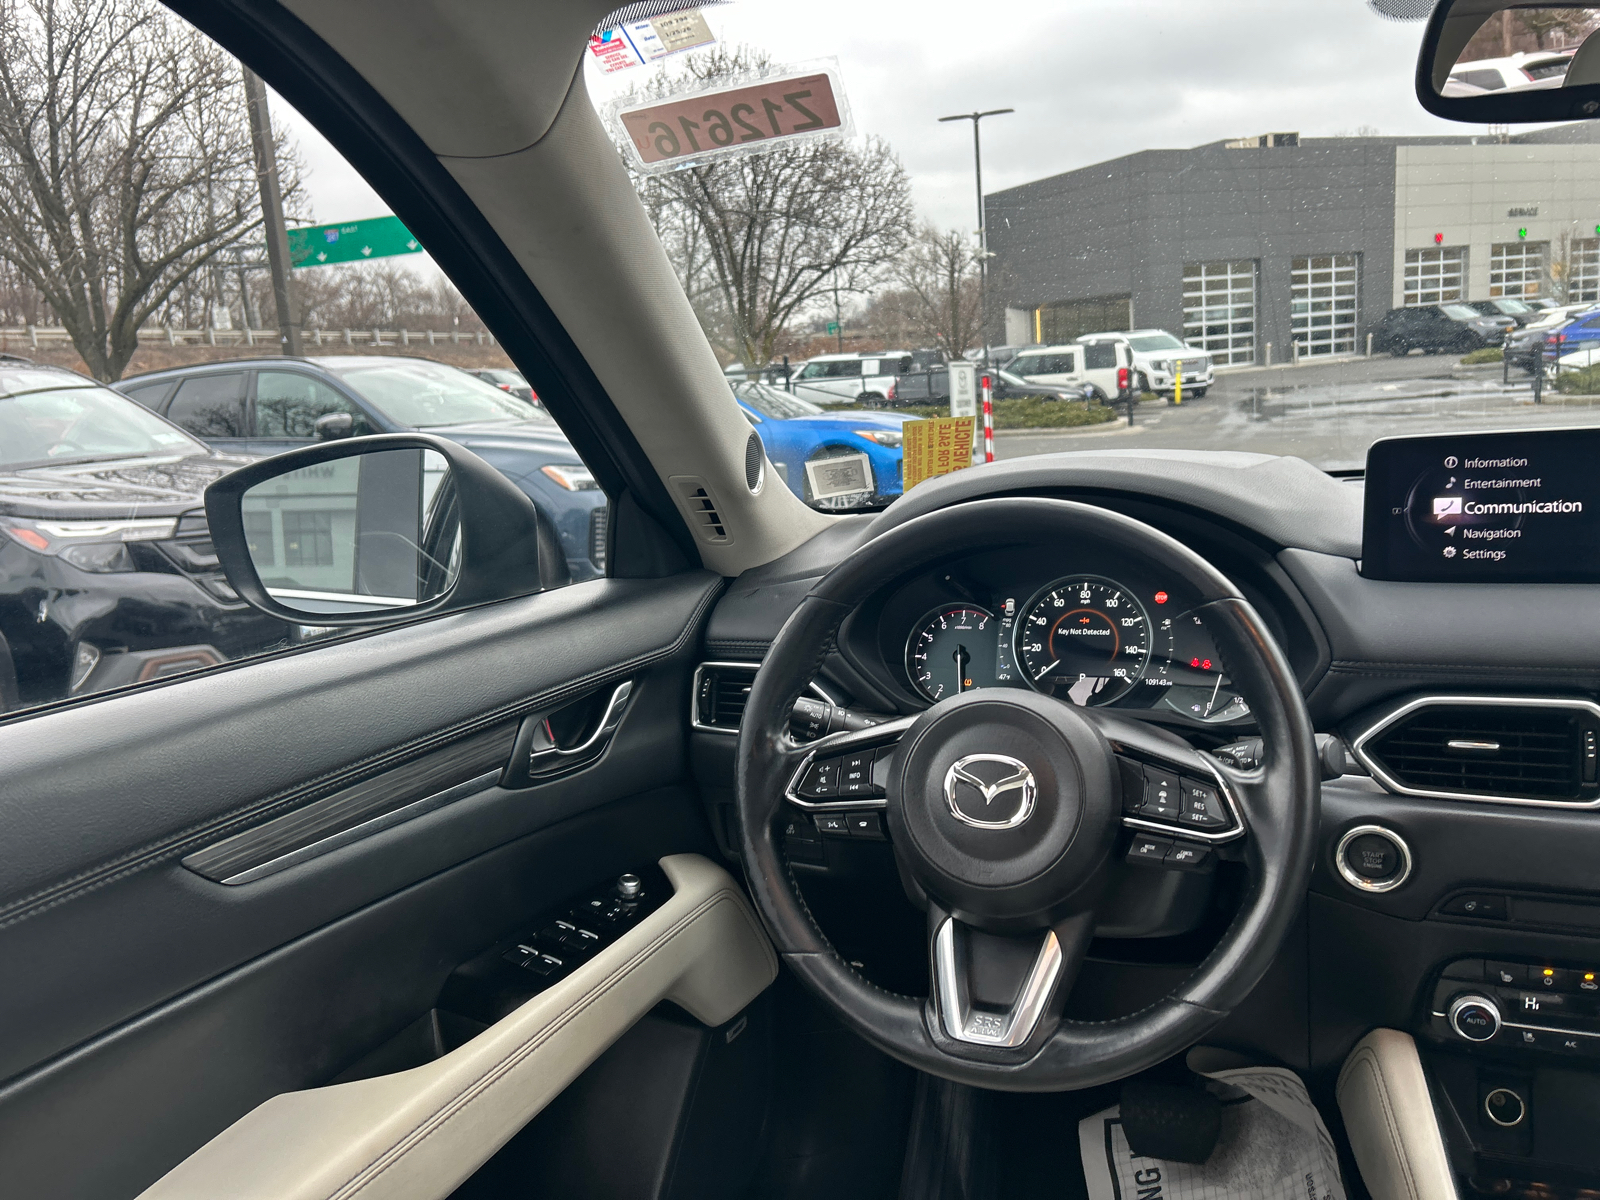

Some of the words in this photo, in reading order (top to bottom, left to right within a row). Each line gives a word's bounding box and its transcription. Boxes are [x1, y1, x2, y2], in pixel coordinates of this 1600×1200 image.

[1464, 458, 1528, 469] Information
[1464, 478, 1542, 490] Entertainment
[1464, 499, 1582, 515] Communication
[1463, 526, 1521, 540] Navigation
[1462, 548, 1506, 561] Settings
[1054, 599, 1064, 607] 60
[1105, 599, 1118, 608] 100
[960, 616, 966, 624] 7
[1036, 617, 1046, 626] 40
[1121, 618, 1134, 626] 120
[1031, 644, 1042, 652] 20
[1124, 646, 1138, 654] 140
[921, 652, 928, 660] 4
[926, 672, 932, 680] 3
[1113, 668, 1126, 676] 160
[1079, 674, 1086, 682] P
[938, 684, 944, 692] 2
[1194, 802, 1205, 810] RES
[1362, 850, 1384, 858] START
[974, 1015, 1002, 1028] SRS
[1466, 1017, 1487, 1026] AUTO
[1564, 1040, 1577, 1048] A/C
